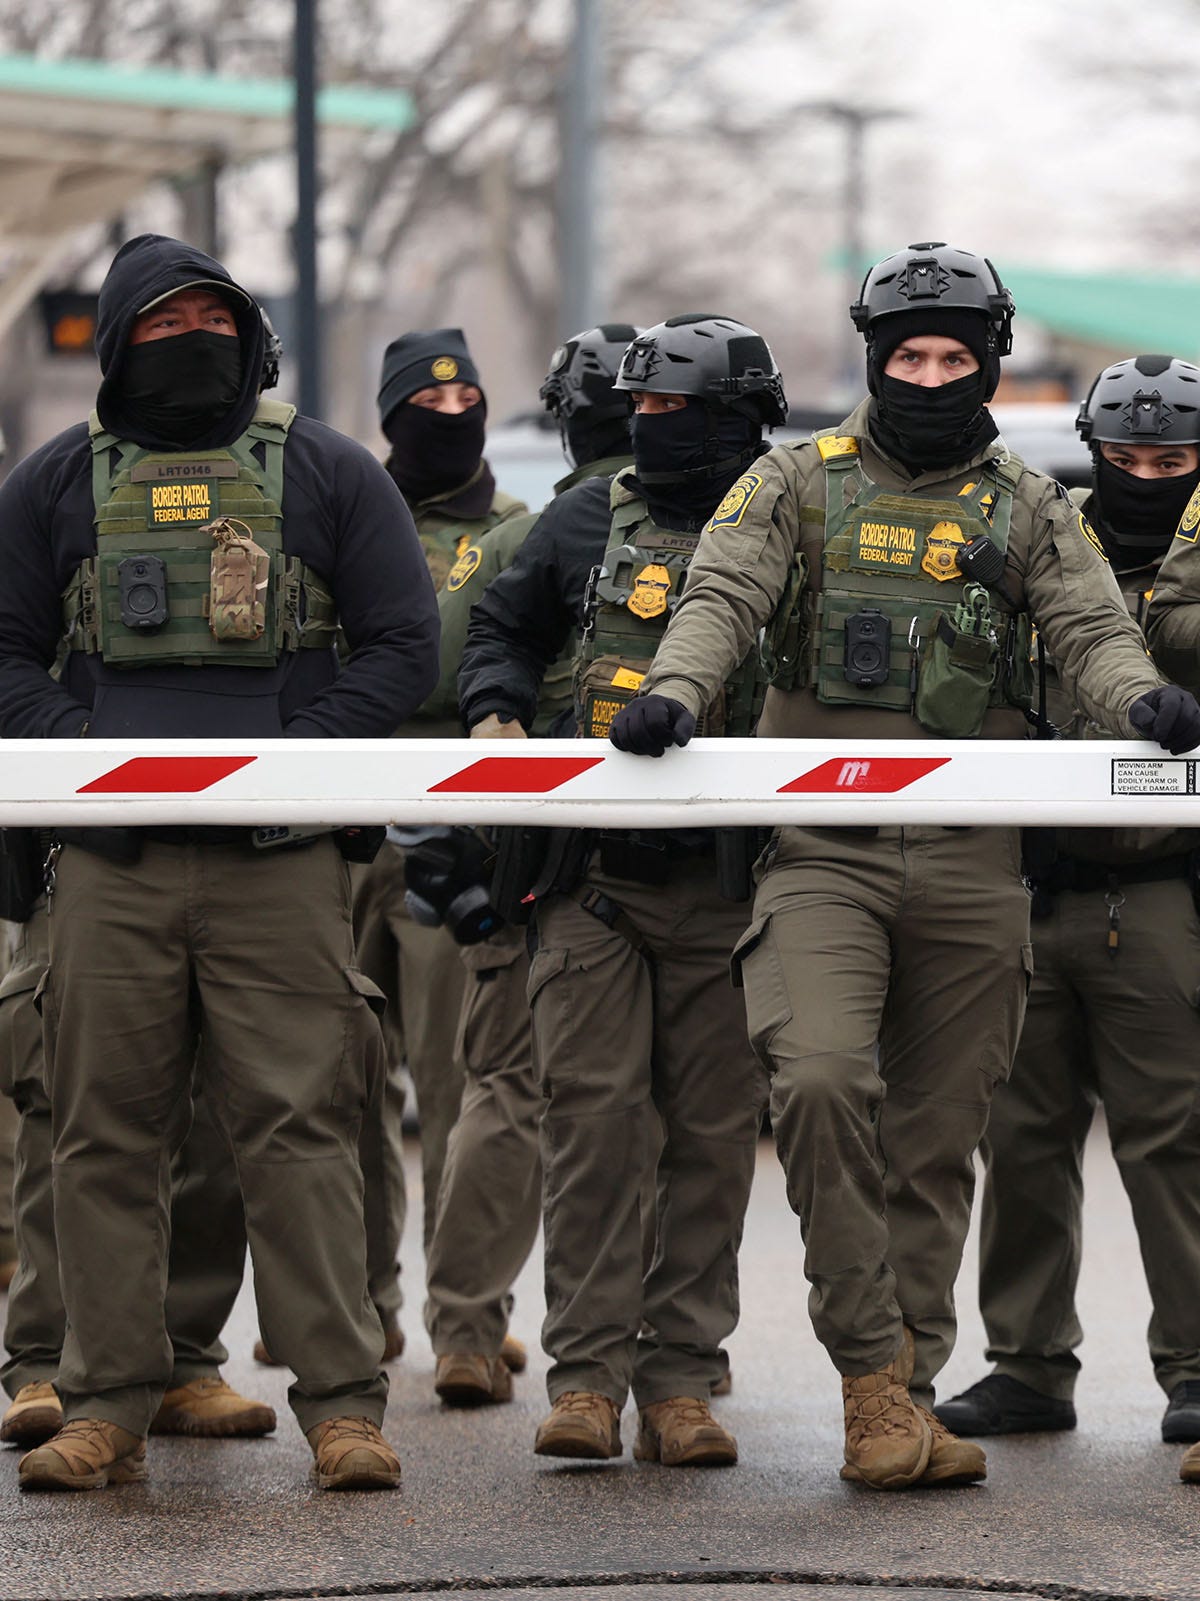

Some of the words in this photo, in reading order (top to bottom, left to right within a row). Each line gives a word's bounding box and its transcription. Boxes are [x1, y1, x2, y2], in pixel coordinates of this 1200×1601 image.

[152, 485, 182, 508] BORDER
[183, 484, 211, 506] PATROL
[154, 508, 185, 522] FEDERAL
[186, 506, 210, 520] AGENT
[859, 523, 888, 548] BORDER
[887, 526, 917, 551] PATROL
[859, 547, 889, 562] FEDERAL
[889, 552, 914, 566] AGENT
[591, 724, 609, 738] FEDE
